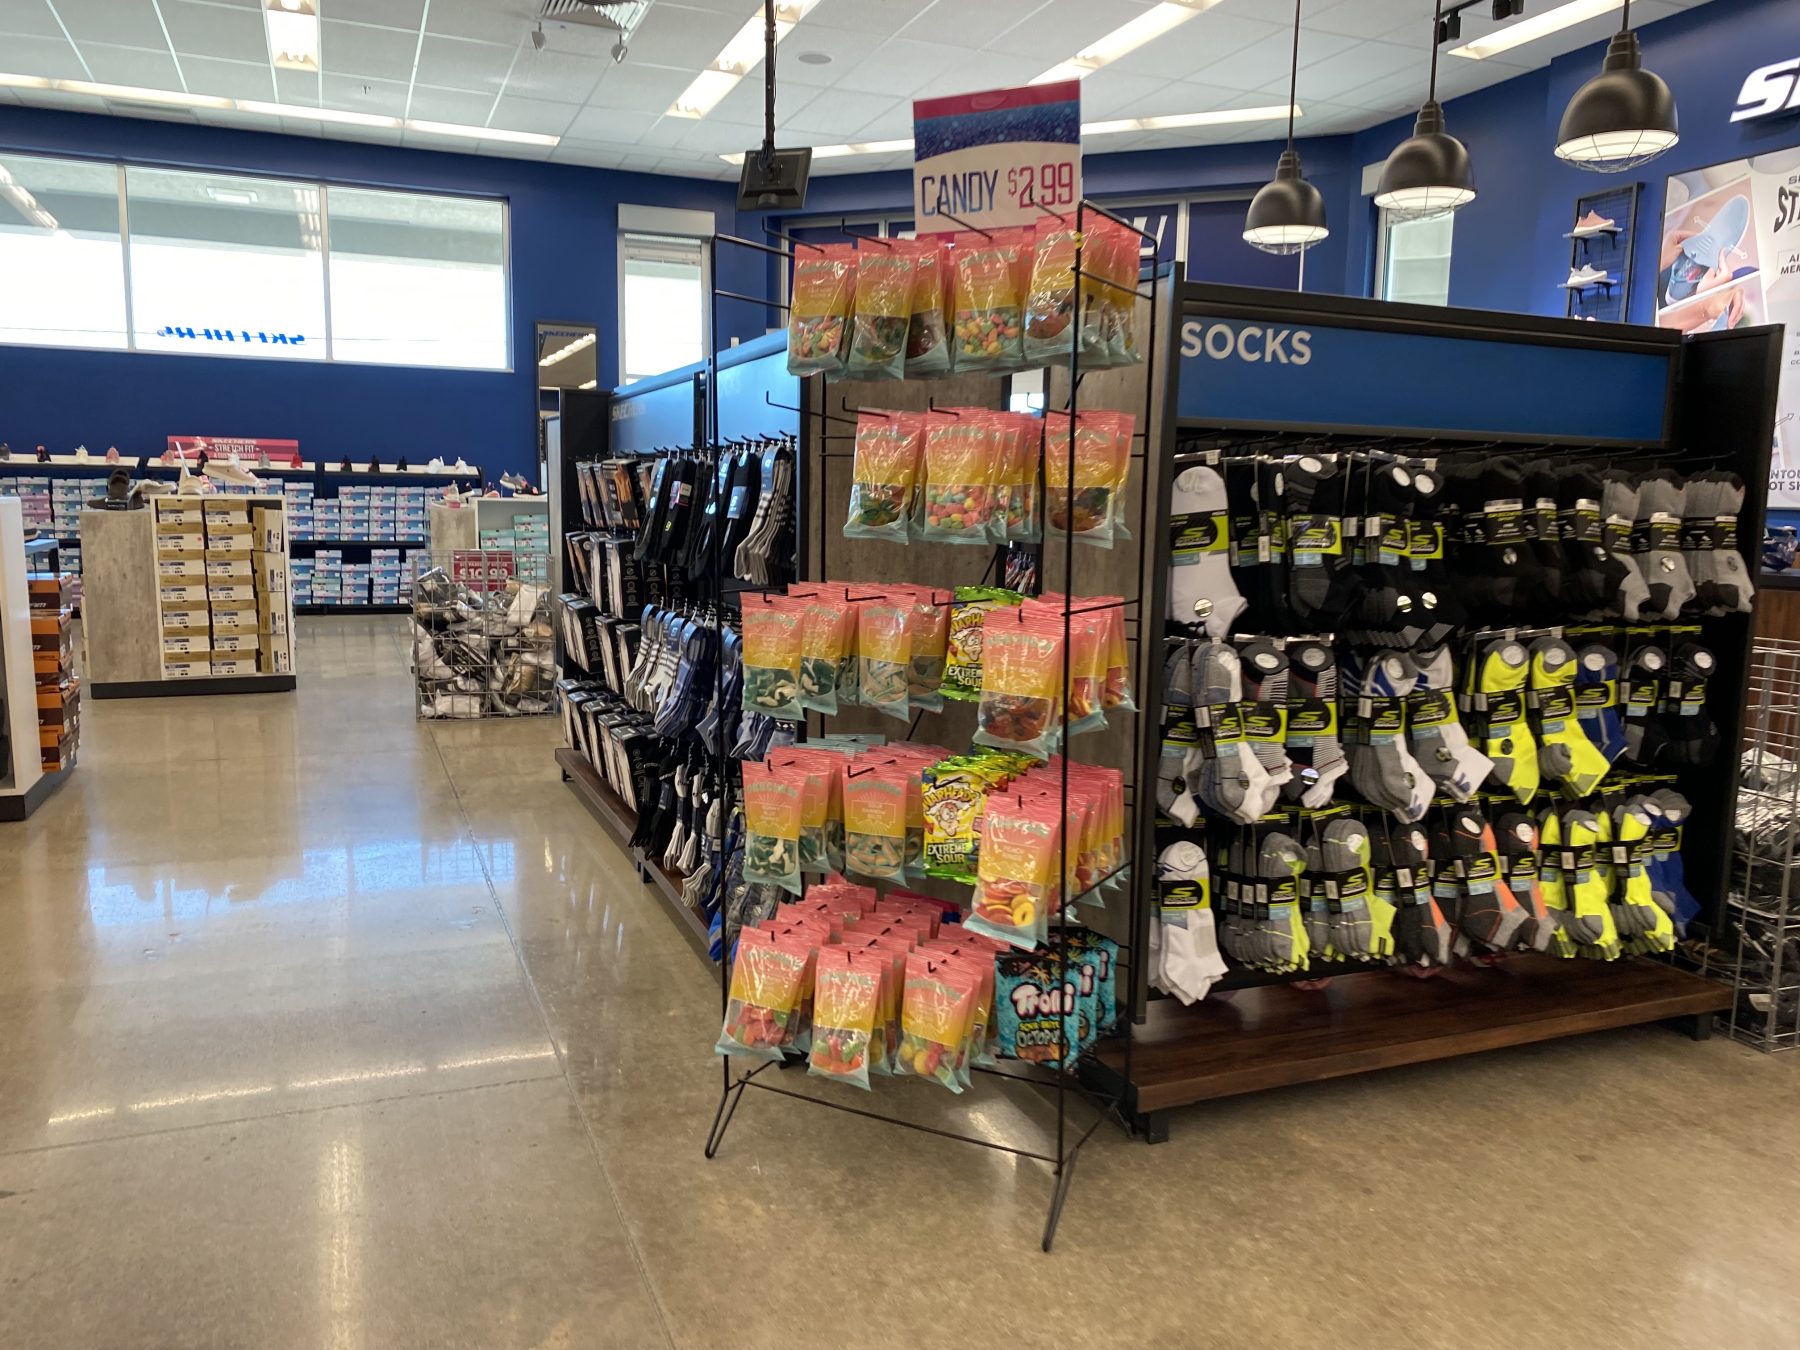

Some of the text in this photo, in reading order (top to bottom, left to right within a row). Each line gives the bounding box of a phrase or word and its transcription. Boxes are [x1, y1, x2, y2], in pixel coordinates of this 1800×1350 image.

[1730, 59, 1800, 123] S
[921, 162, 1074, 216] CANDY $299
[1773, 185, 1800, 233] ST
[1180, 320, 1312, 366] SOCKS
[214, 444, 255, 454] STRETCH FIT
[459, 567, 509, 581] $1099
[951, 612, 984, 633] WARH
[948, 666, 982, 679] EXTRE
[922, 785, 978, 811] WARHEADS
[927, 842, 967, 855] EXTREME
[936, 853, 966, 864] SOUR
[1016, 1029, 1063, 1049] OCTOPU
